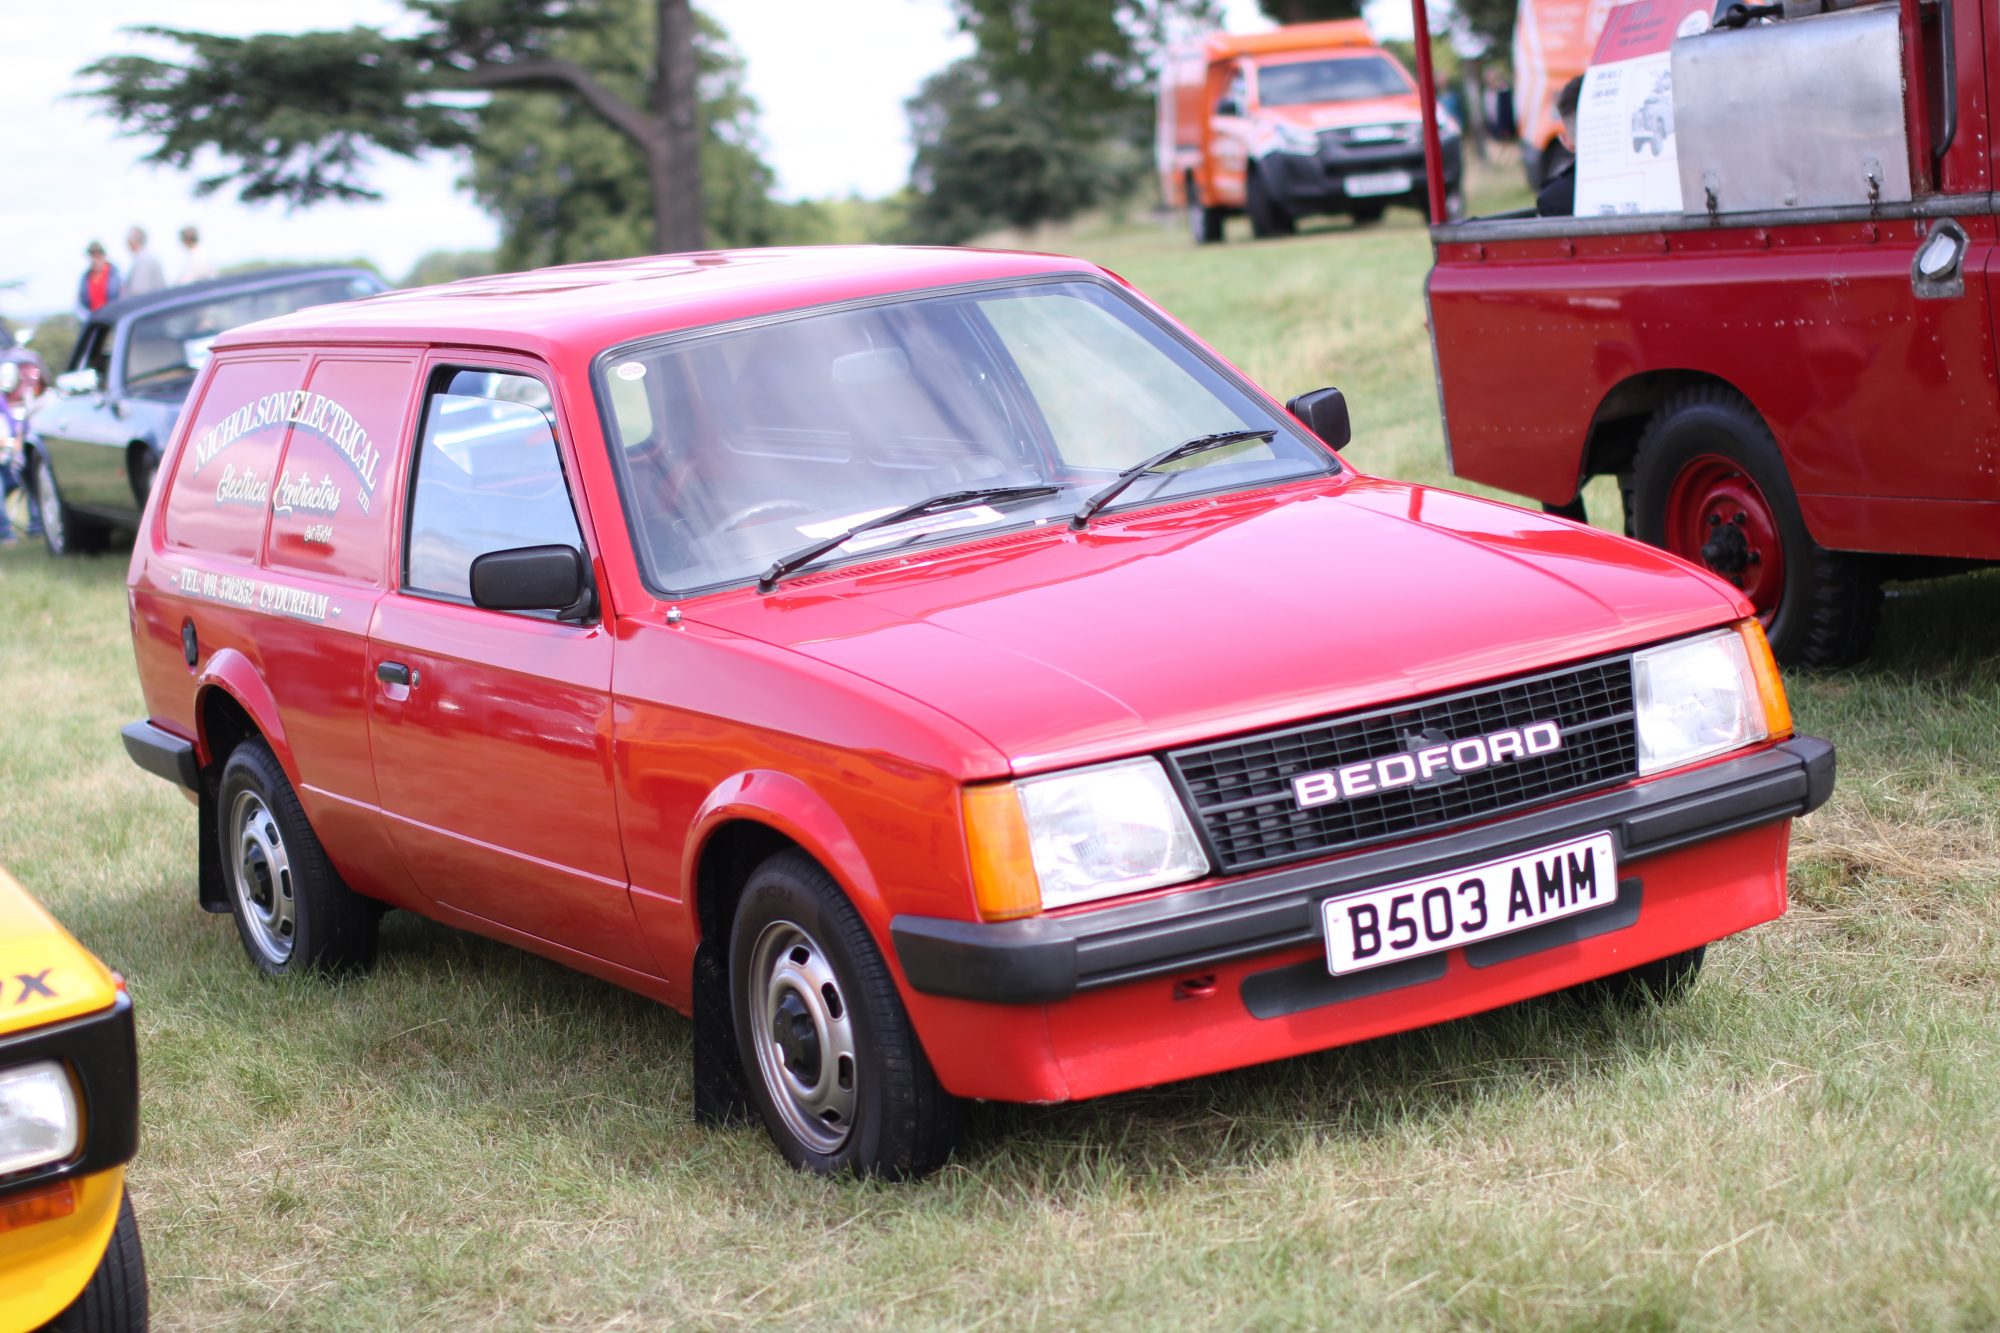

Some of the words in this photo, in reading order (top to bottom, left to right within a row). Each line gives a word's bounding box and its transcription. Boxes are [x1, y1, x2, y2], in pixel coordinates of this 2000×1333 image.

[194, 391, 293, 473] NICHOLSON
[286, 390, 380, 491] ELECTRICAL
[217, 464, 272, 502] Electrical
[274, 471, 340, 513] Contractors
[203, 573, 218, 598] 091
[274, 586, 330, 619] DURHAM
[1293, 721, 1561, 808] BEDFORD
[1347, 878, 1488, 960] B503
[1507, 846, 1598, 924] AMM
[0, 968, 59, 1006] X
